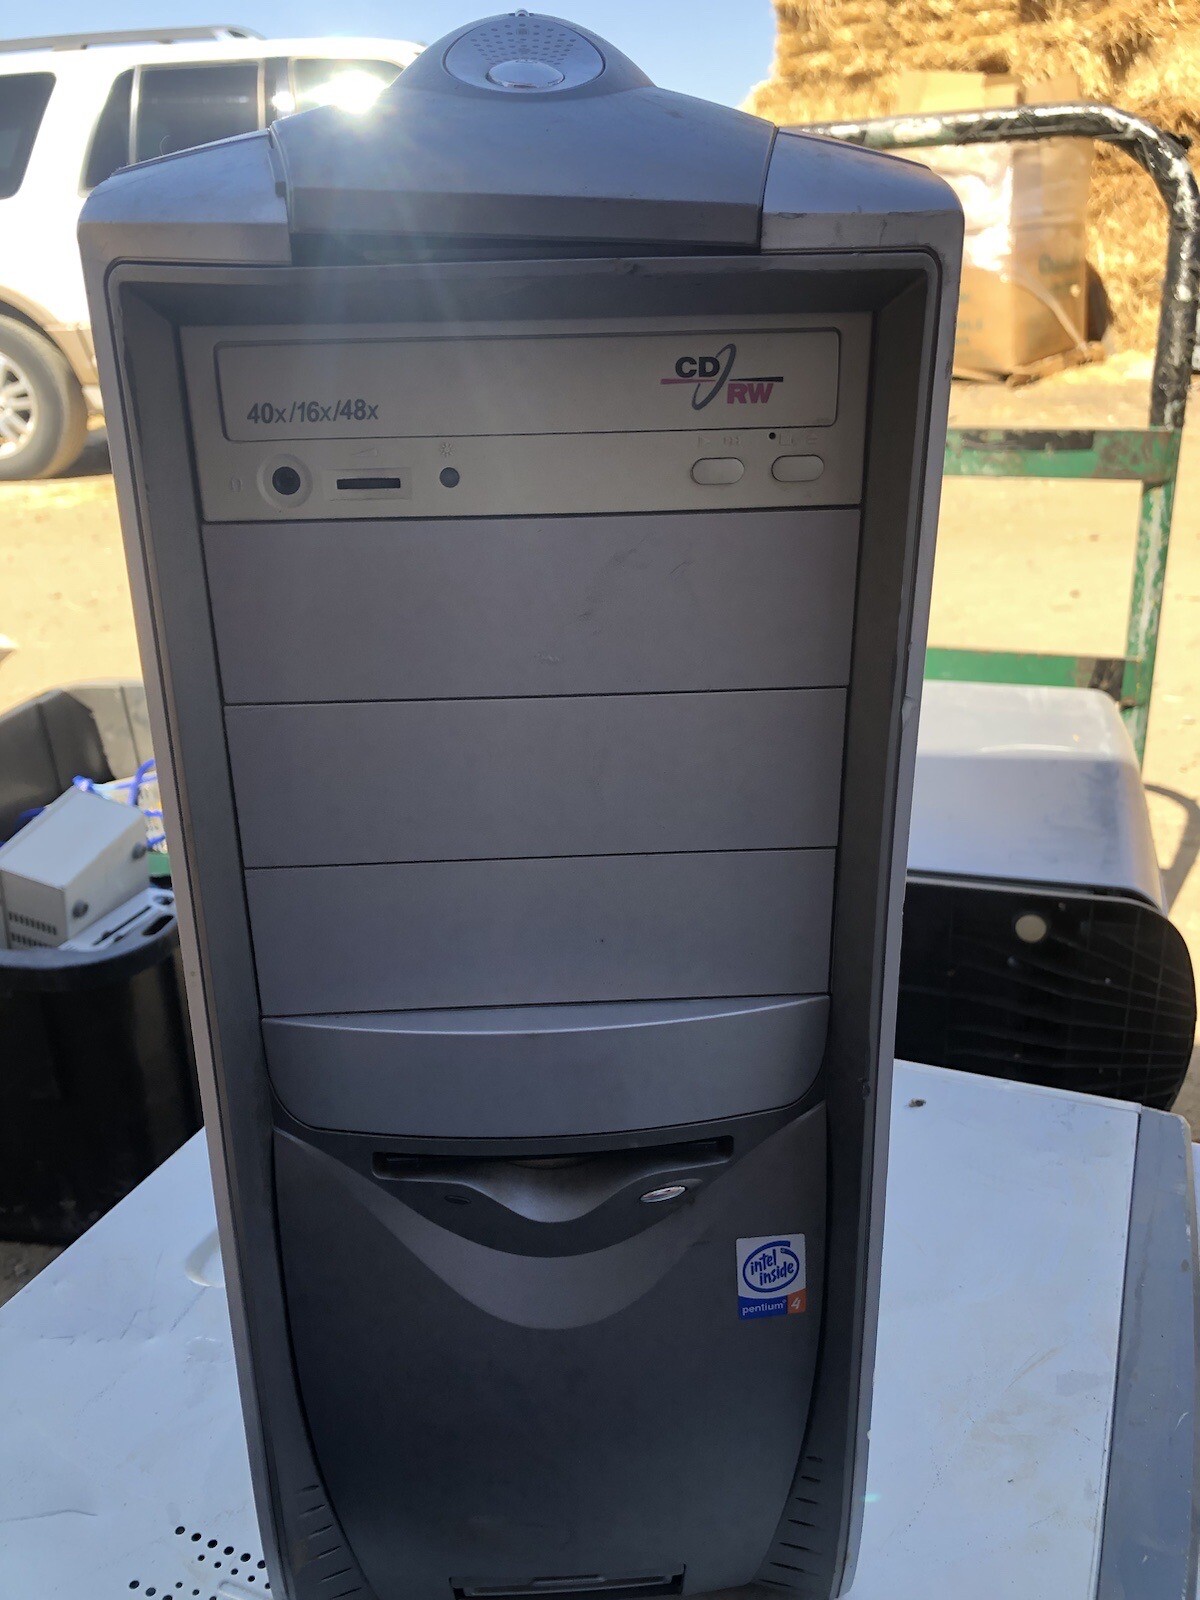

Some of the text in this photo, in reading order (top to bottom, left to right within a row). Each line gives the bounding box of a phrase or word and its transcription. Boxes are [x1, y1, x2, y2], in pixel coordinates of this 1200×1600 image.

[675, 357, 720, 378] CD
[726, 383, 773, 404] RW
[247, 399, 379, 424] 40x/16x/48x
[750, 1249, 777, 1275] intel
[759, 1261, 794, 1286] inside
[791, 1297, 801, 1310] 4
